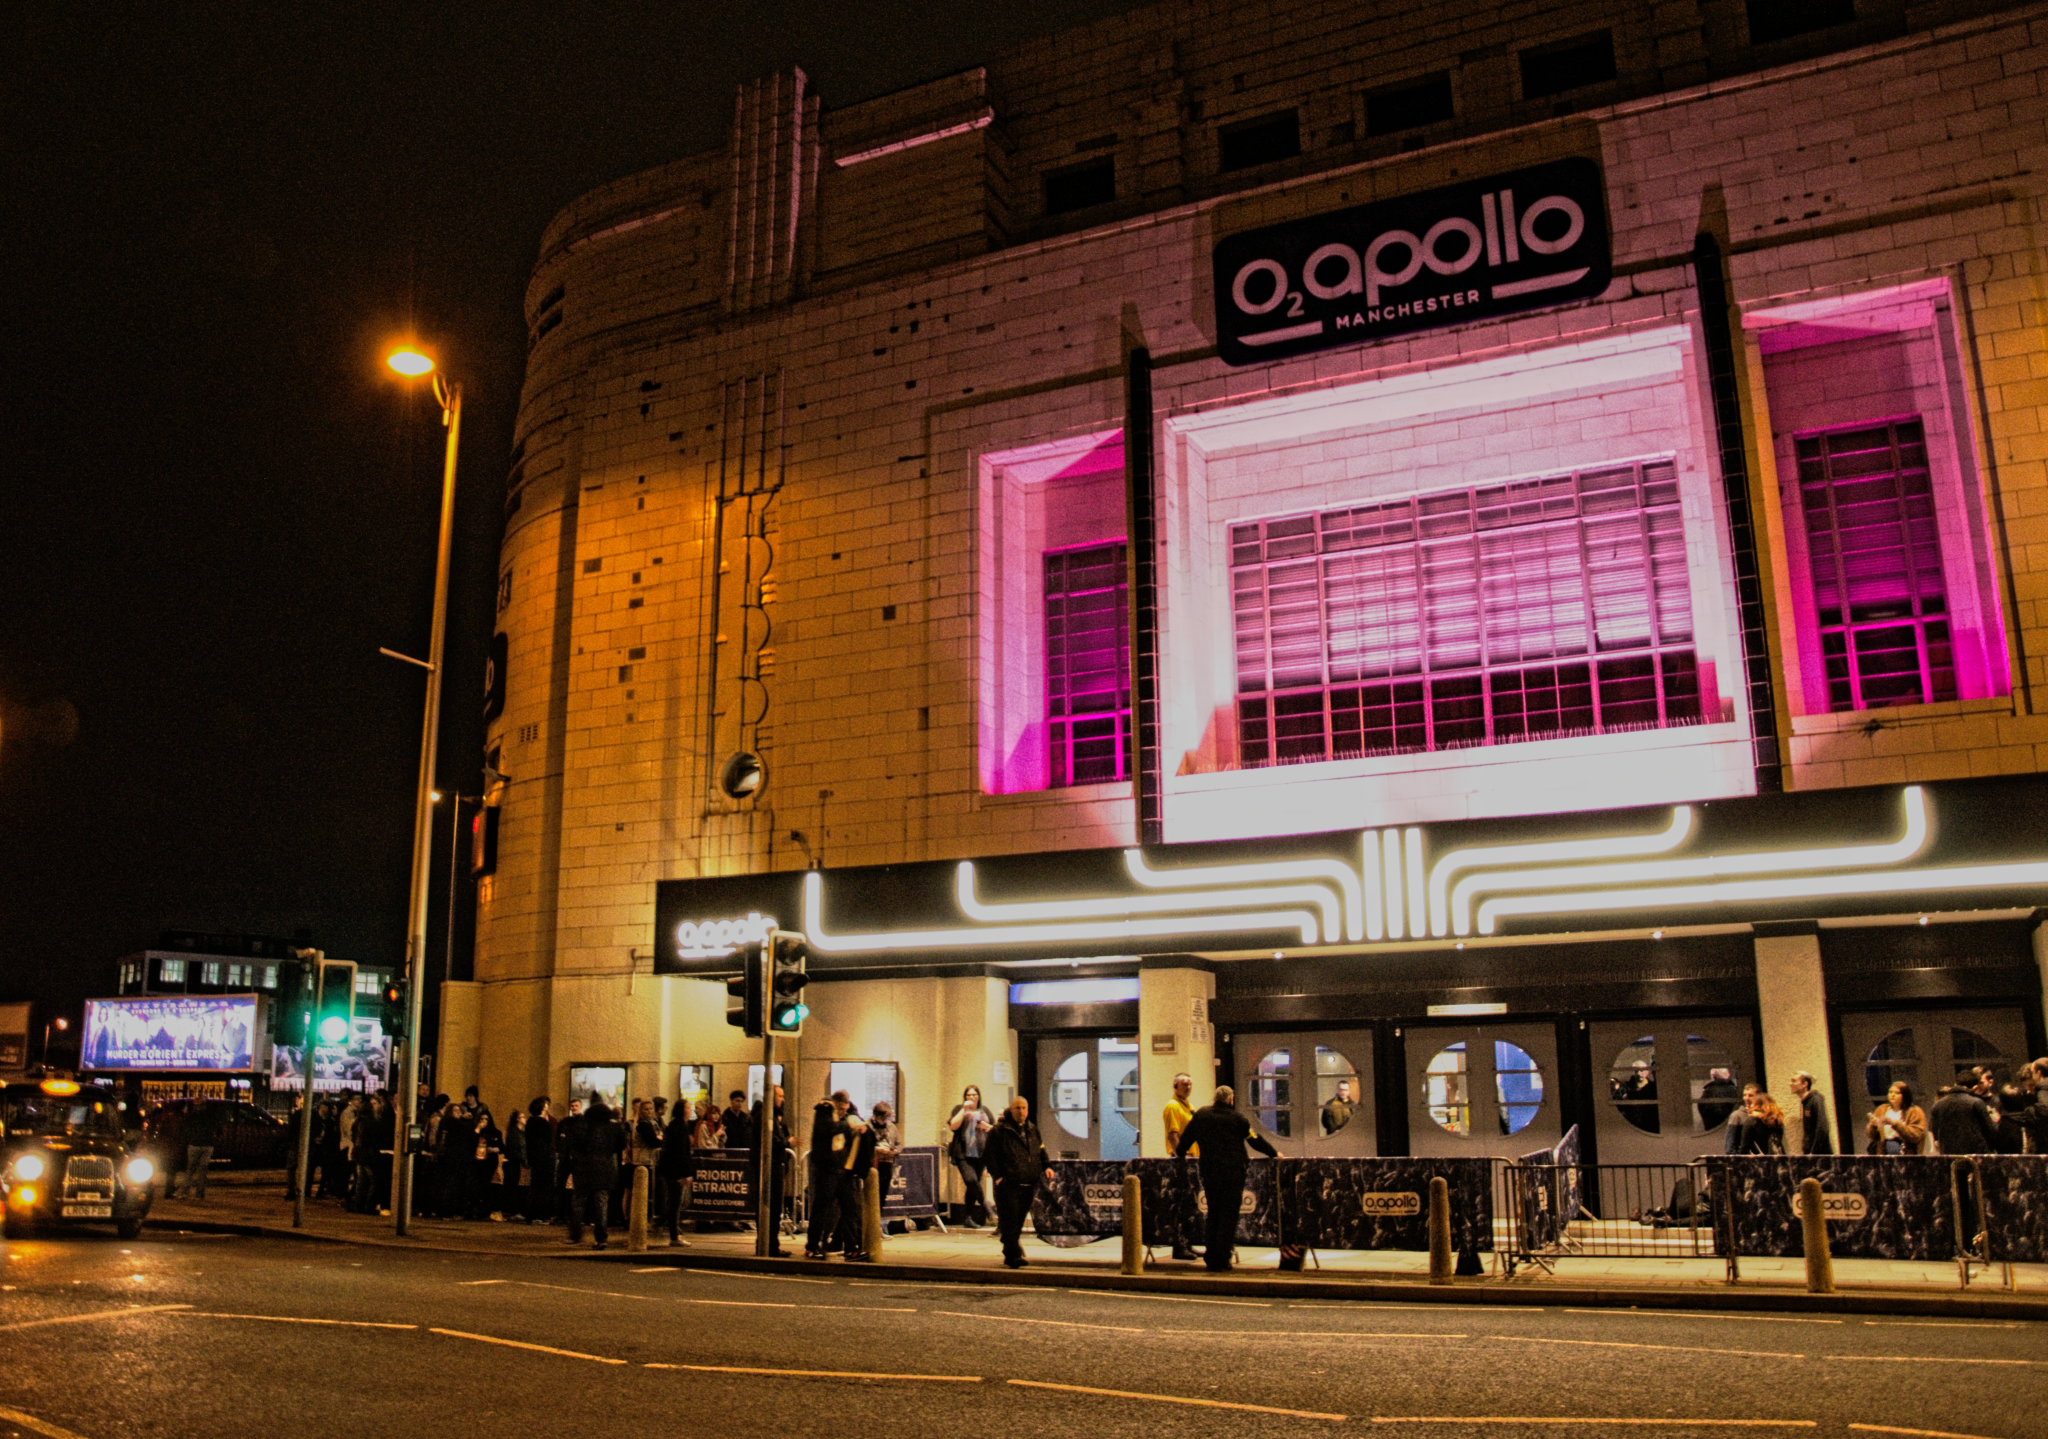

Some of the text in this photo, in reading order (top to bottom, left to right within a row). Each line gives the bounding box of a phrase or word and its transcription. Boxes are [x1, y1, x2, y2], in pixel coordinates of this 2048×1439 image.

[1336, 289, 1480, 330] MANCHESTER
[106, 1049, 139, 1060] MURDER
[148, 1048, 184, 1060] ORIENT
[186, 1048, 226, 1060] EXPRESS
[315, 1047, 347, 1057] CHOOSE
[315, 1063, 345, 1073] HYBRID
[696, 1169, 744, 1181] PRIORITY
[692, 1182, 748, 1194] ENTRANCE
[712, 1199, 745, 1207] CUSTOMERS
